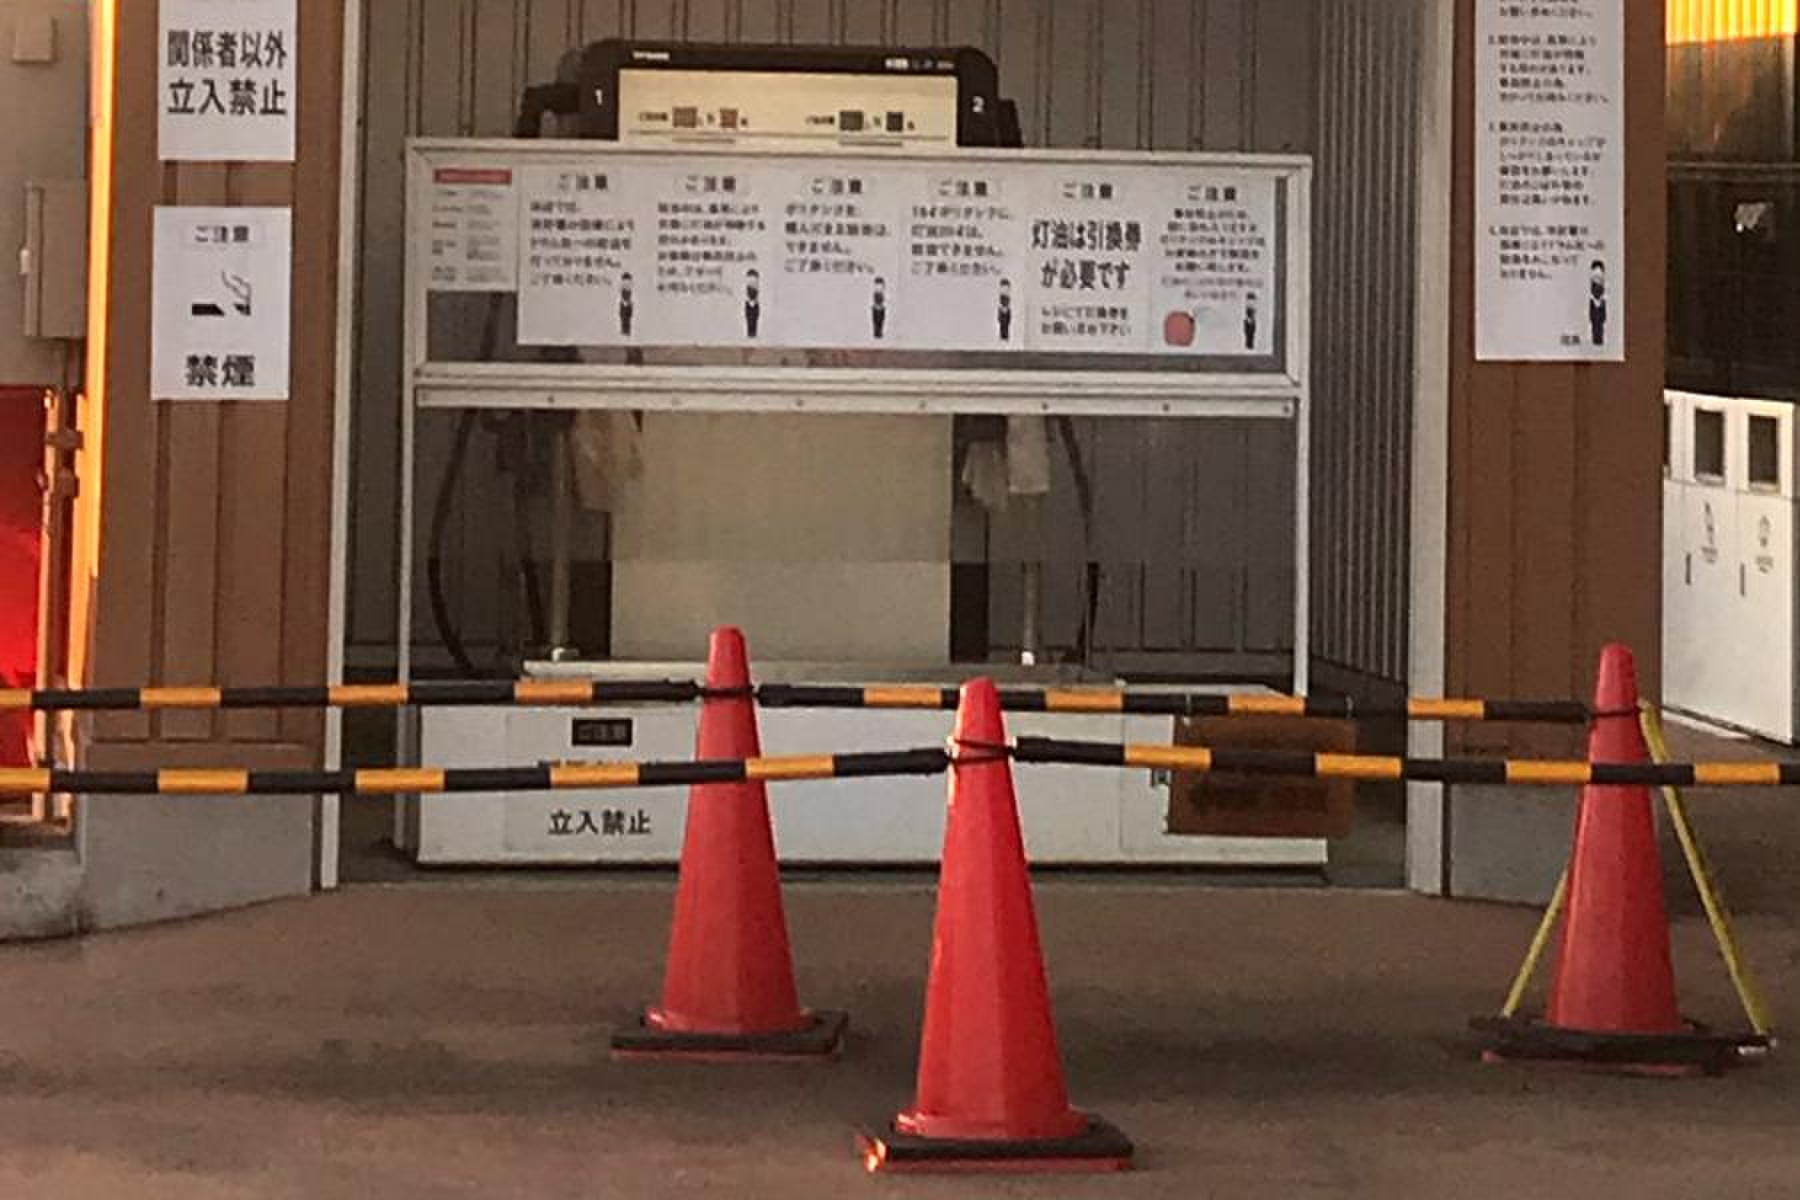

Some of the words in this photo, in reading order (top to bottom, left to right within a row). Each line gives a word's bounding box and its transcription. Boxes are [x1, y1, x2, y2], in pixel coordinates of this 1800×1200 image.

[167, 30, 287, 71] 関係者以外
[168, 77, 287, 115] 立入禁止
[1041, 257, 1131, 290] が必要です
[185, 353, 256, 390] 禁煙
[549, 810, 651, 836] 立入禁止
